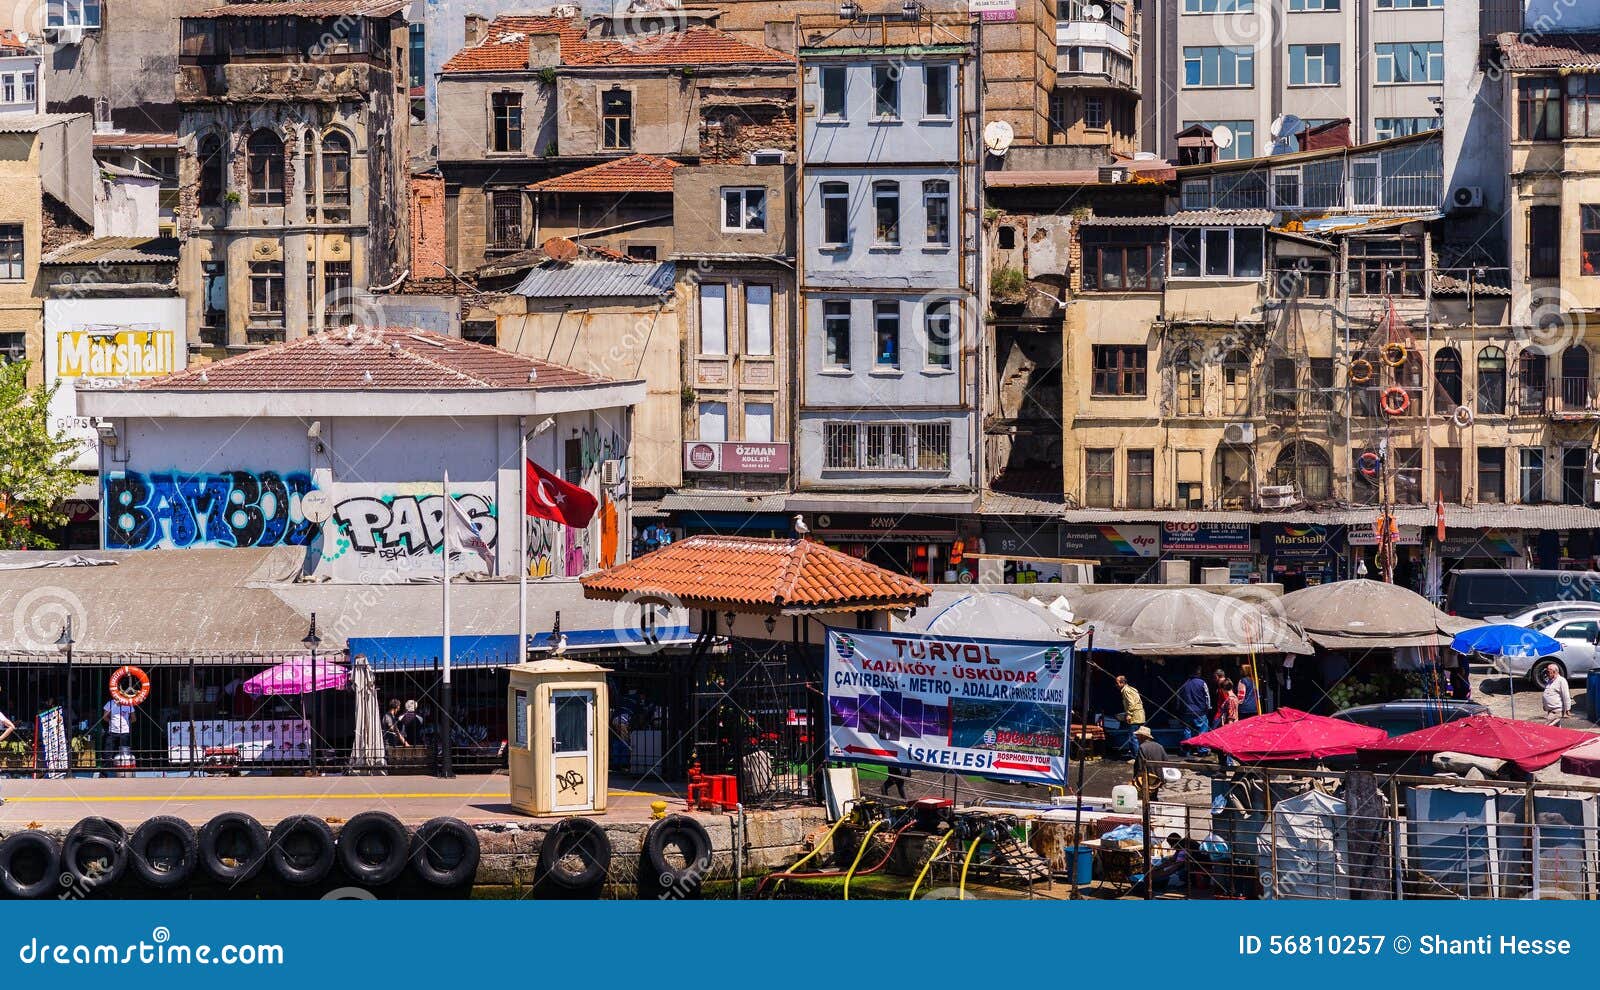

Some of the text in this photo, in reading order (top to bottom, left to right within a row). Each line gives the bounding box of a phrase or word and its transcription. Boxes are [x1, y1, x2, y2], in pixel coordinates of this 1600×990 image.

[60, 331, 172, 374] Marshall
[735, 445, 776, 456] ÖZMAN
[103, 470, 320, 550] BAMBOO
[870, 517, 896, 528] KAYA
[1132, 535, 1155, 547] dyo
[1275, 535, 1326, 545] Marshall
[892, 639, 1001, 665] TURYOL
[861, 658, 937, 677] KADIKÖY
[953, 665, 1038, 684] ÜSKÜDAR
[909, 676, 950, 695] METRO
[961, 681, 1009, 700] ADALAR
[907, 743, 993, 770] İSKELESİ
[996, 752, 1051, 765] BOSPHORUS TOUR
